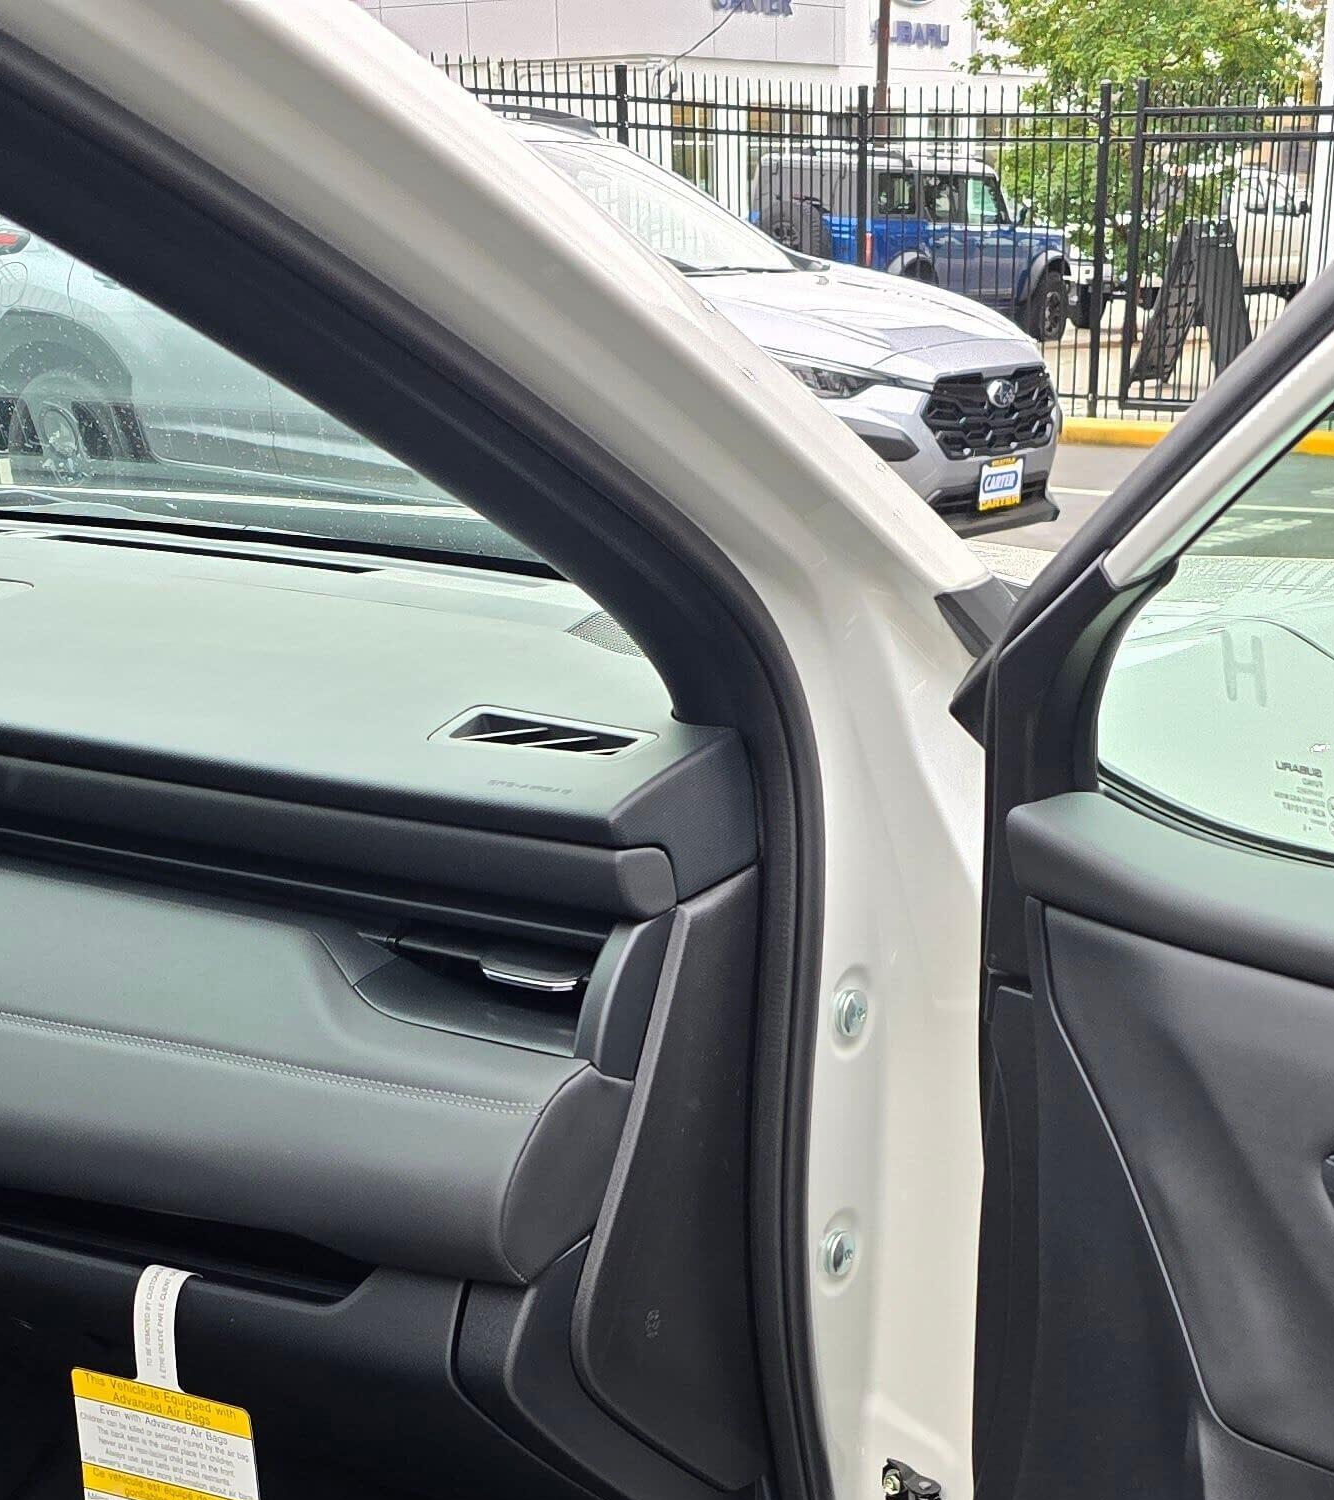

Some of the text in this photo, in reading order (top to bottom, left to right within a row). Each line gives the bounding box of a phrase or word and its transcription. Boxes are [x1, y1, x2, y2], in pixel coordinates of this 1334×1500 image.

[984, 472, 1017, 491] CARTER
[84, 1372, 236, 1420] This Vehicle is Equipped with
[113, 1393, 211, 1427] Advanced Air Bags
[100, 1405, 228, 1446] Even with Advanced Air Bags
[93, 1466, 105, 1478] Ce
